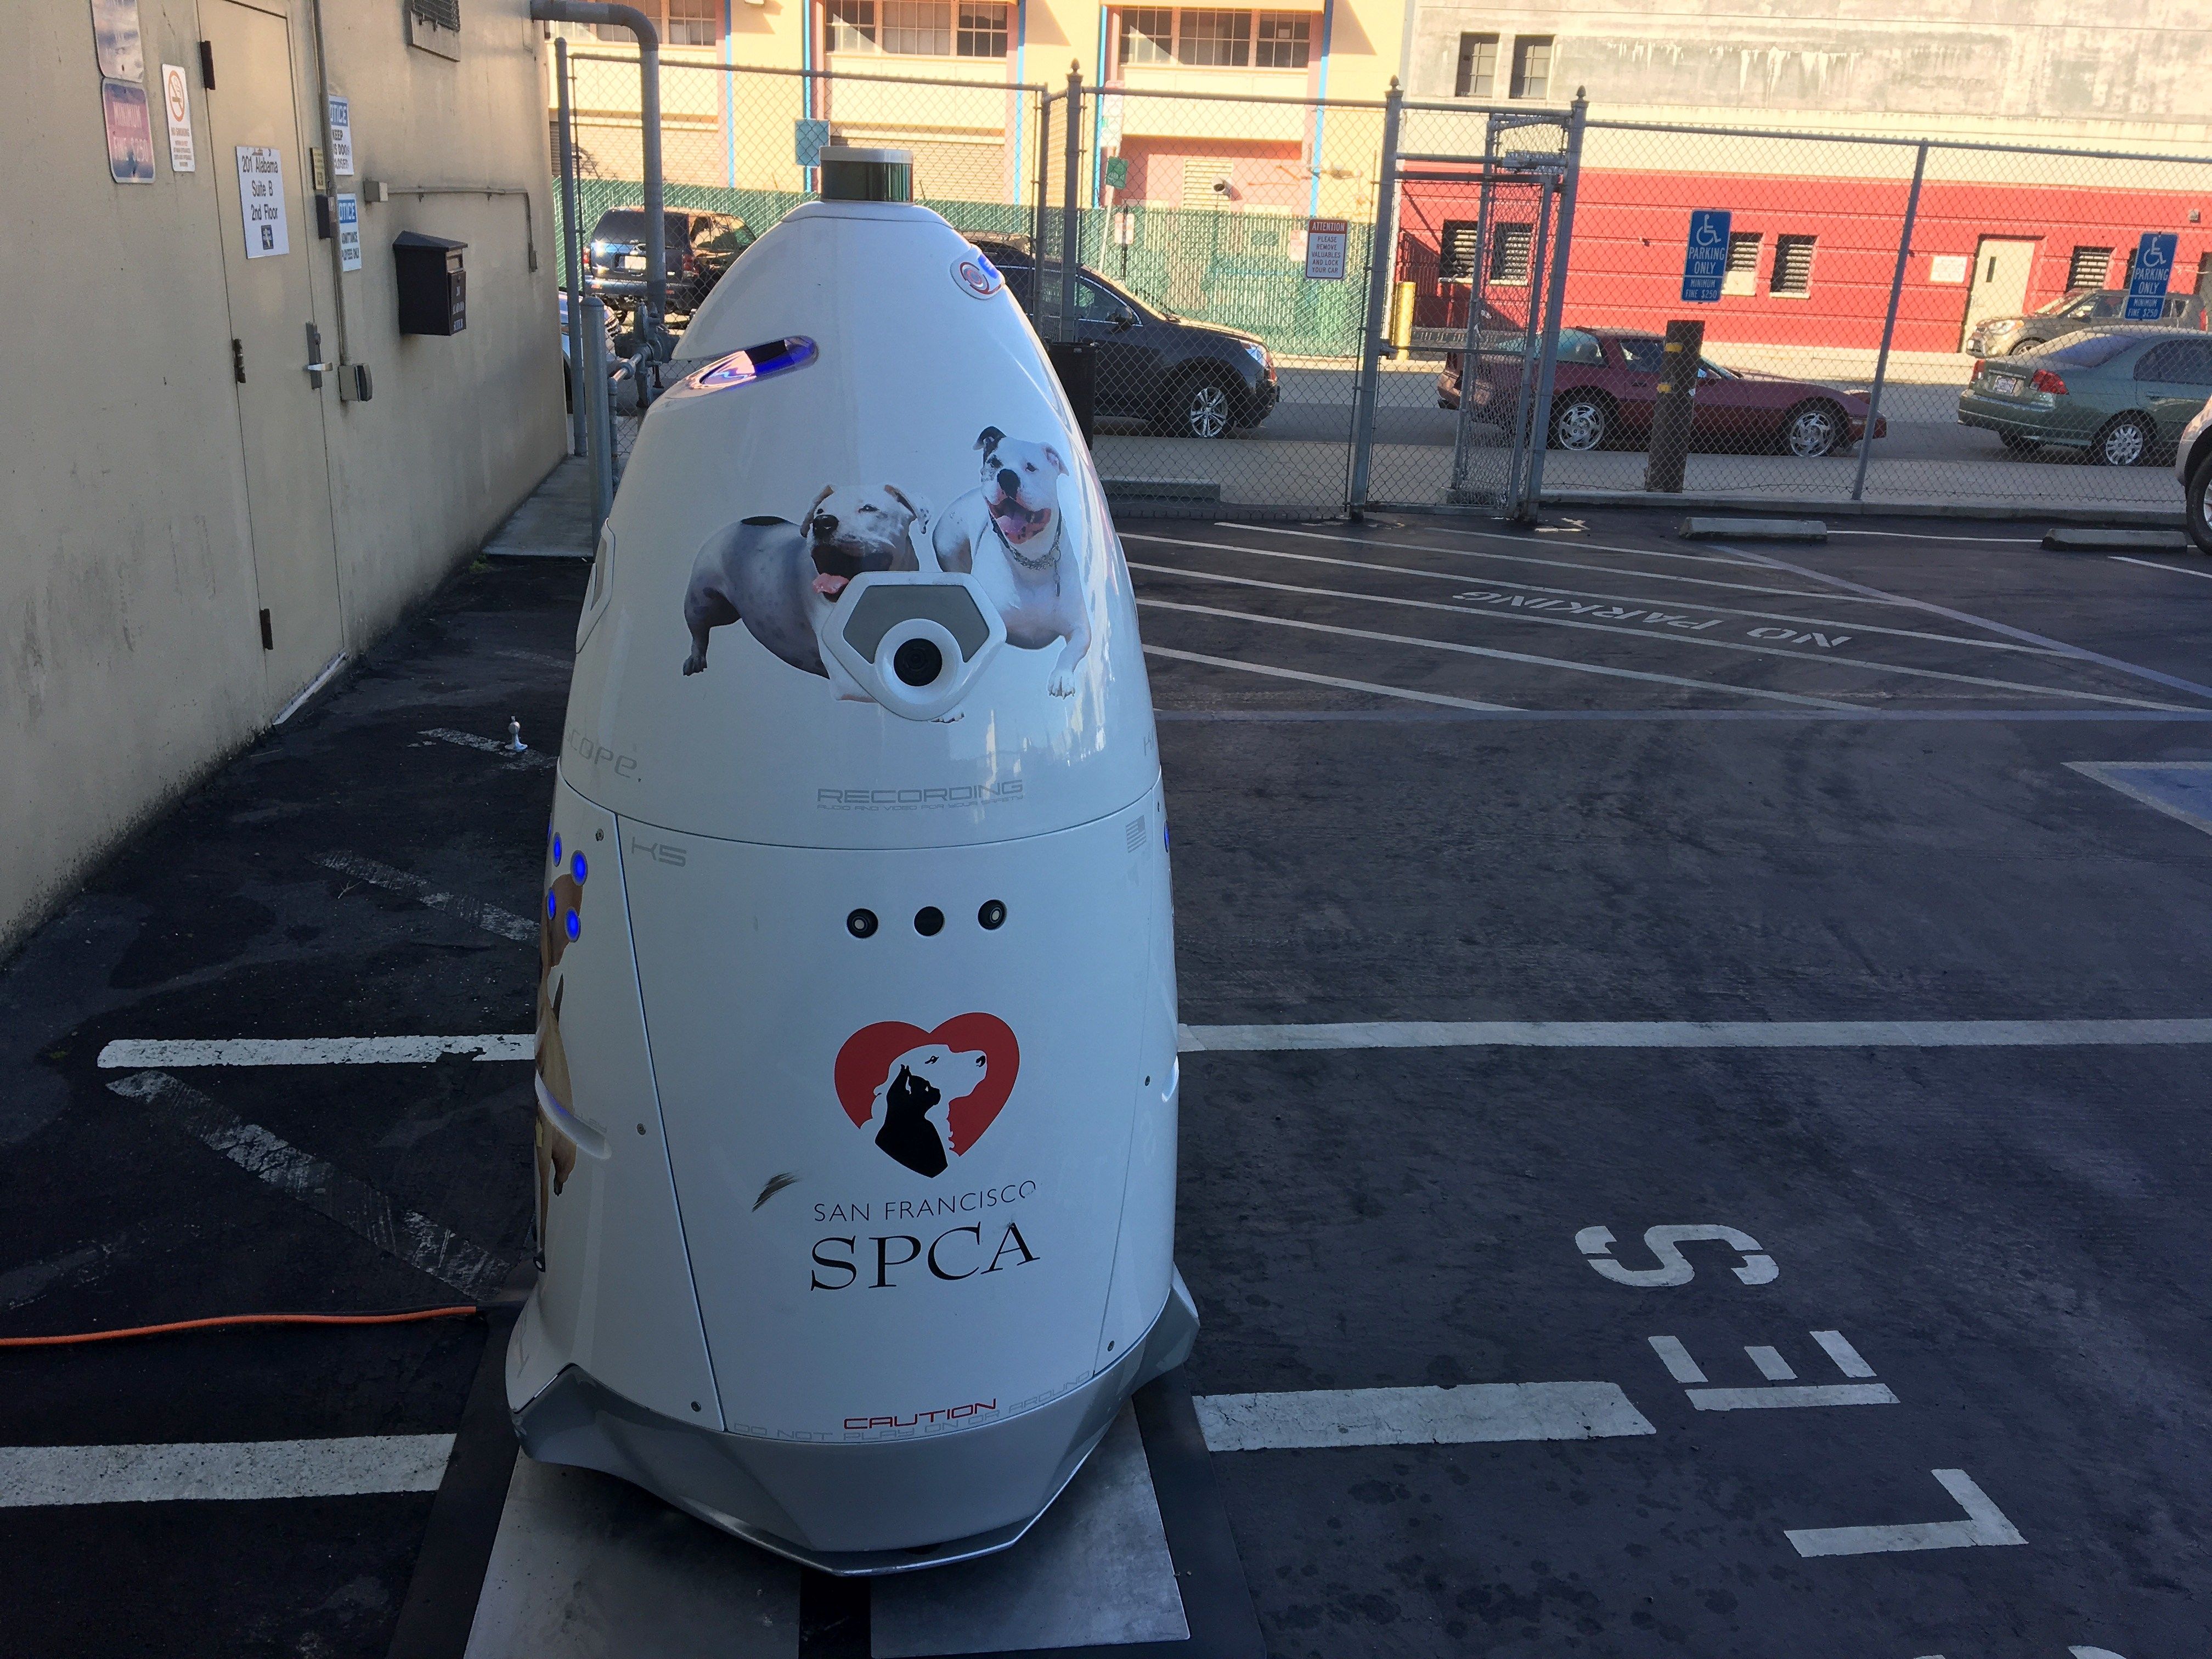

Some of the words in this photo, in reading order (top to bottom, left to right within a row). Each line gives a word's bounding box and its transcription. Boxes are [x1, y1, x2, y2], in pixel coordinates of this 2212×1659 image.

[329, 104, 347, 123] OTICE
[241, 155, 253, 173] 201
[256, 157, 278, 174] Alabama
[251, 180, 266, 198] Suite
[268, 180, 273, 196] B
[251, 204, 262, 221] 2nd
[264, 204, 278, 220] Floor
[338, 202, 356, 221] OTICE
[1312, 222, 1345, 231] ATTENTION
[1689, 247, 1726, 261] PARKING
[1694, 261, 1716, 274] ONLY
[2134, 268, 2169, 281] PARKING
[1690, 278, 1716, 287] MINIMUM
[2138, 281, 2160, 295] ONLY
[1685, 289, 1699, 298] FINE
[1701, 289, 1717, 299] $250
[2133, 298, 2158, 307] MINIMUM
[2128, 308, 2140, 317] FINE
[2142, 308, 2159, 318] $250
[1452, 591, 1724, 631] PARKING
[1747, 627, 1853, 648] NO
[817, 779, 1023, 804] RECORDING
[948, 800, 978, 809] YOUR
[981, 794, 1024, 805] SAFETY
[631, 837, 687, 868] K5
[814, 1203, 870, 1222] SAN
[885, 1180, 1036, 1221] FRANCISCO
[810, 1221, 1041, 1291] SPCA
[733, 1423, 768, 1436] DO
[777, 1429, 833, 1441] NOT
[843, 1426, 915, 1441] PLAY
[924, 1419, 959, 1434] ON
[968, 1409, 1000, 1426] OR
[1008, 1370, 1090, 1414] AROUND
[843, 1398, 996, 1430] CAUTION
